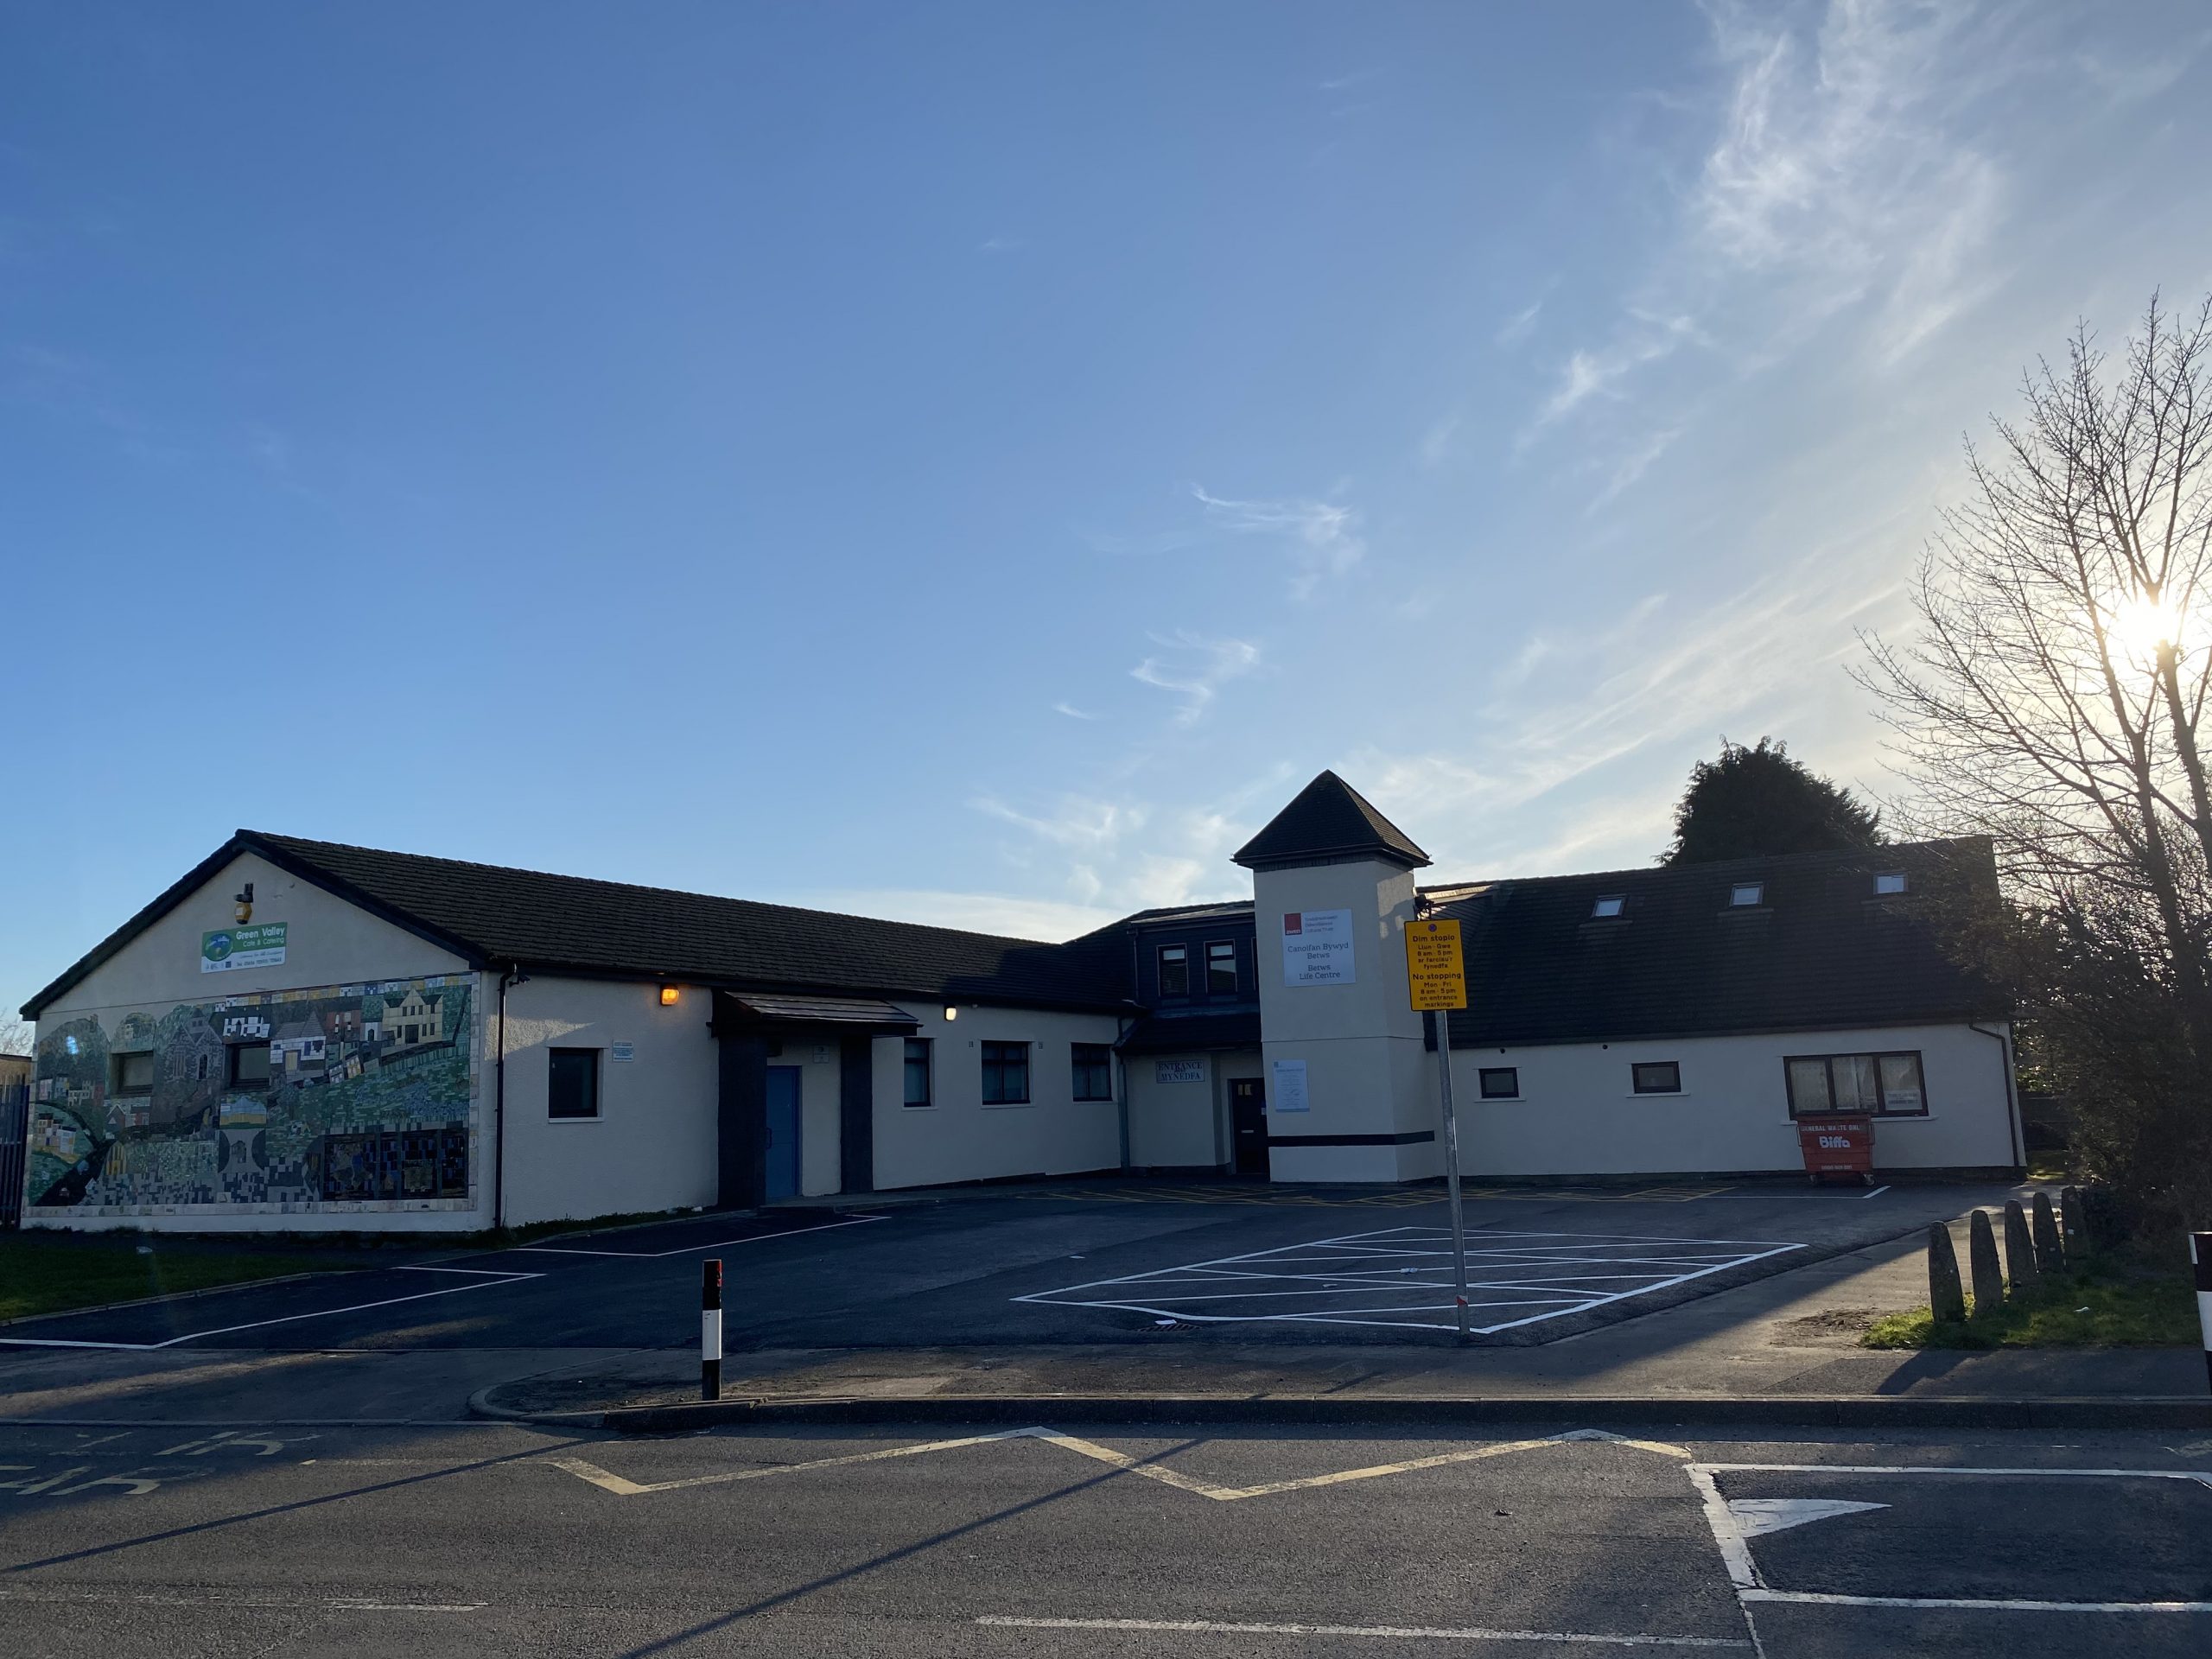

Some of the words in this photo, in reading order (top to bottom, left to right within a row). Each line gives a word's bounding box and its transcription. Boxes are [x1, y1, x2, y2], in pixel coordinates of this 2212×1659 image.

[236, 931, 258, 940] Green
[262, 926, 285, 938] Valley
[1287, 944, 1321, 952] Canolfan
[1323, 942, 1349, 950] Bywyd
[1159, 1061, 1203, 1071] ENTRANCE
[1160, 1071, 1200, 1081] MYNEDFA
[1819, 1135, 1851, 1148] Biffa
